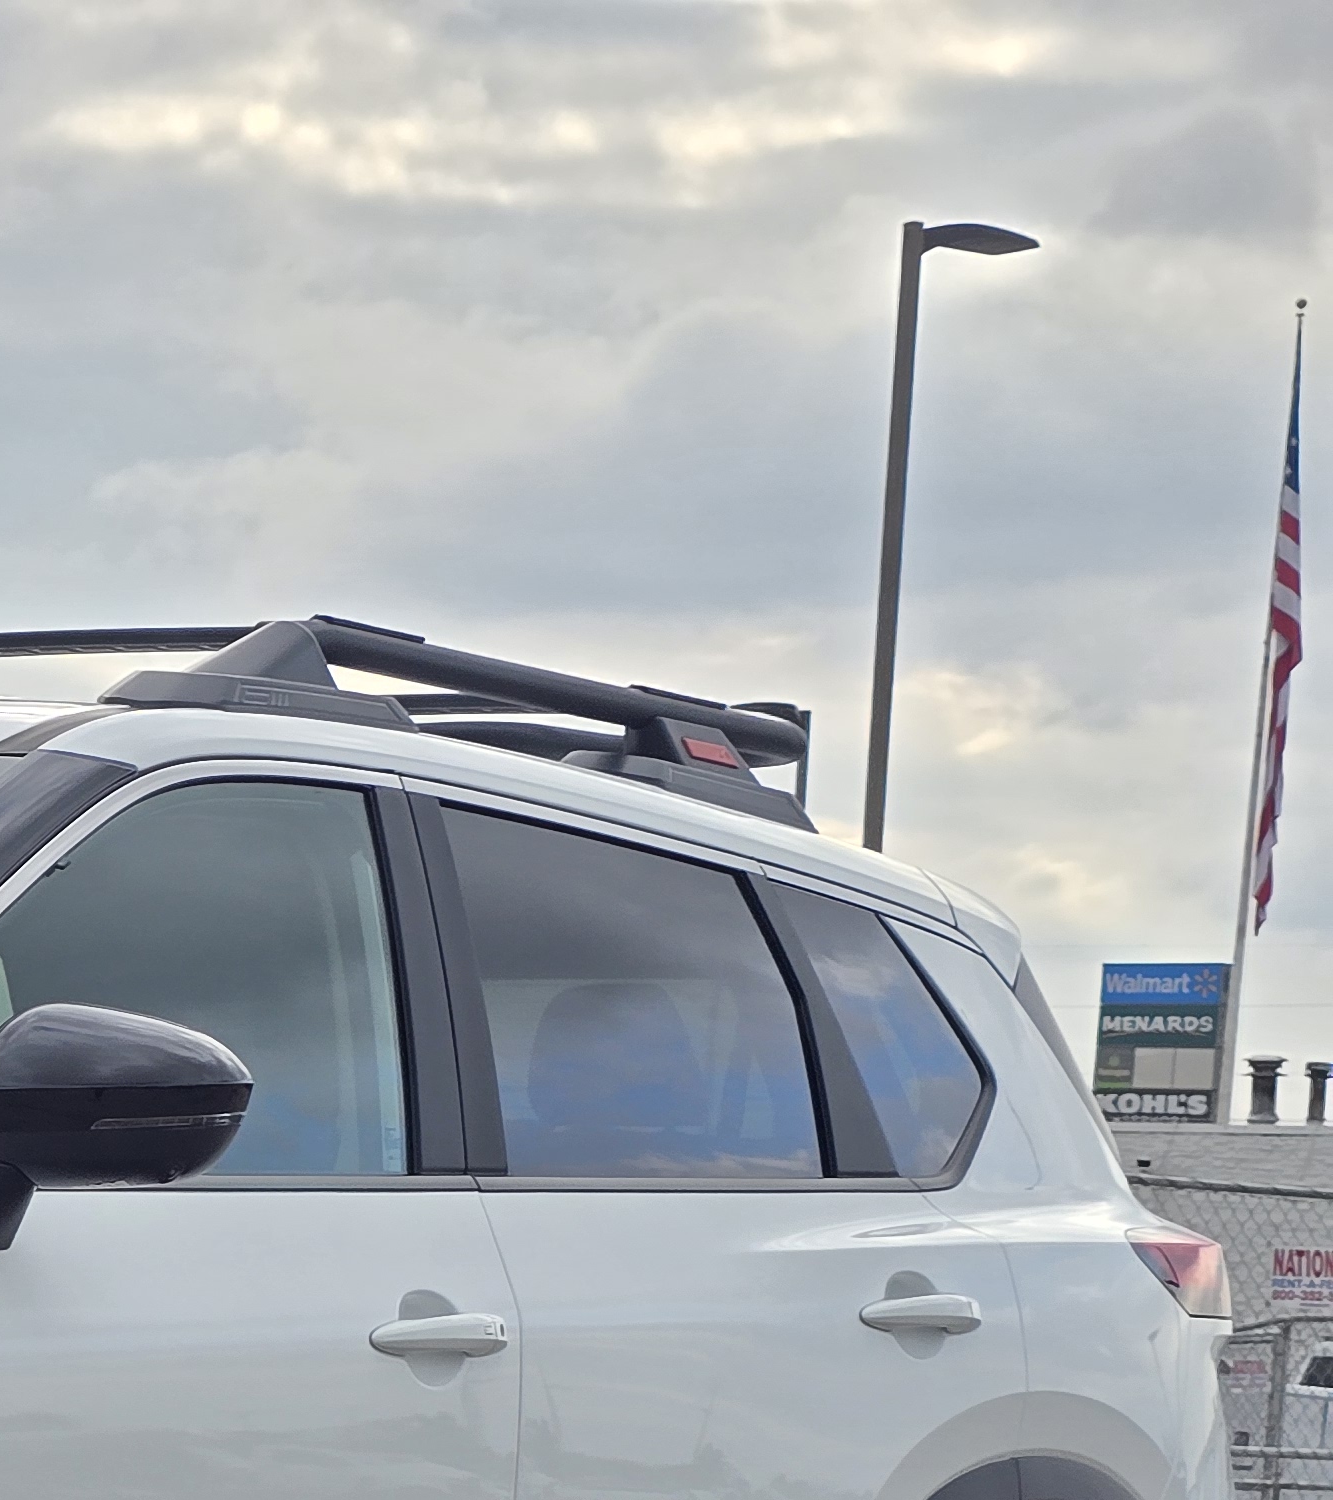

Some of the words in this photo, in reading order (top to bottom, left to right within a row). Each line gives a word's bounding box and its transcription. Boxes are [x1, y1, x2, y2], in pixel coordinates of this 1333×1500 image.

[1106, 972, 1190, 994] Walmart
[1102, 1015, 1213, 1032] MENARDS
[1096, 1094, 1208, 1115] KOHL'S
